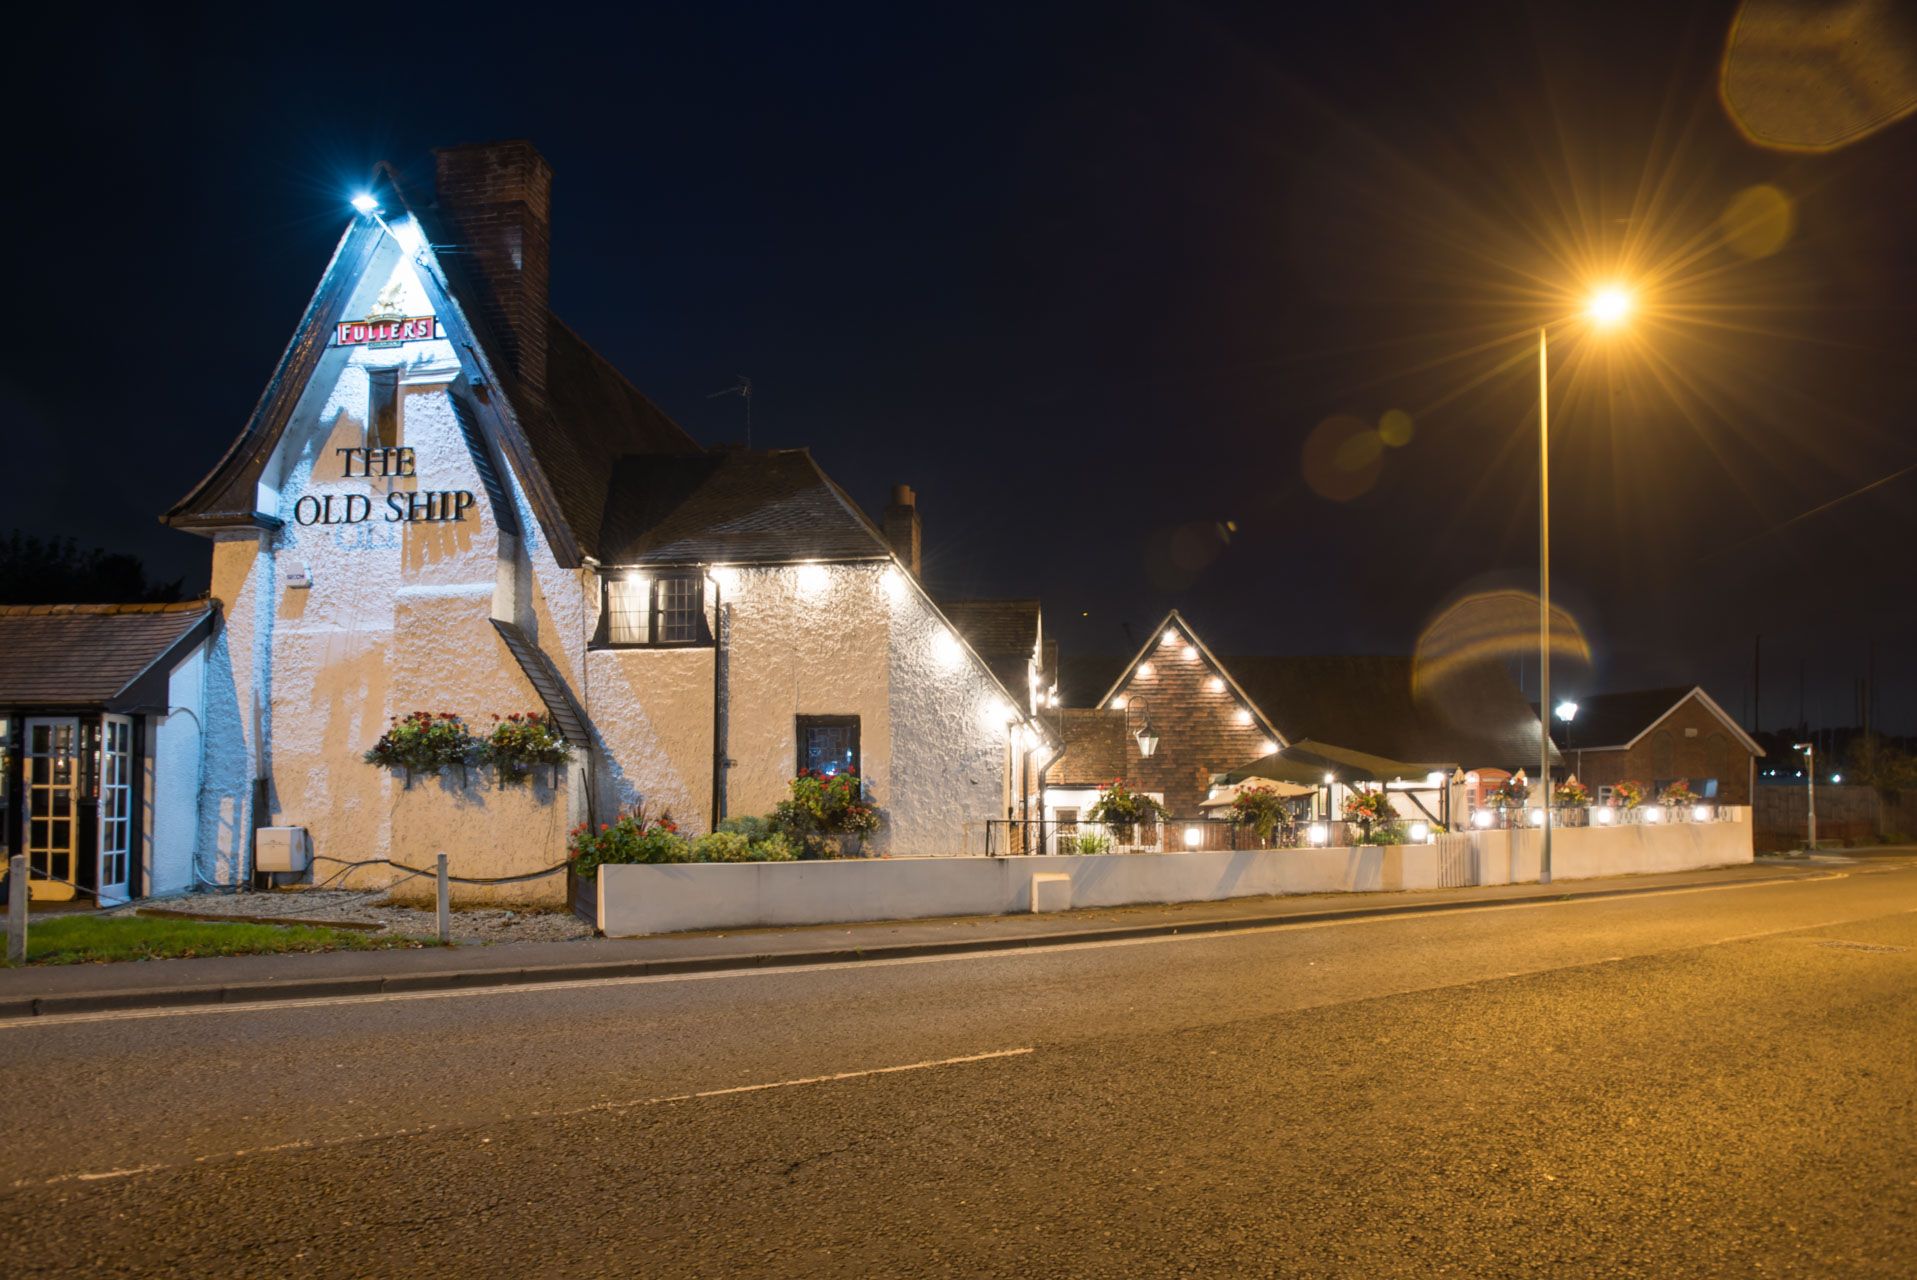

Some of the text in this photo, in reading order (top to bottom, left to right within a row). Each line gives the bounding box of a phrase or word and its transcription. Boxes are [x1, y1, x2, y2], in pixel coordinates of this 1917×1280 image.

[341, 319, 427, 341] FULLER'S
[336, 446, 416, 478] THE
[293, 490, 475, 526] OLD SHIP
